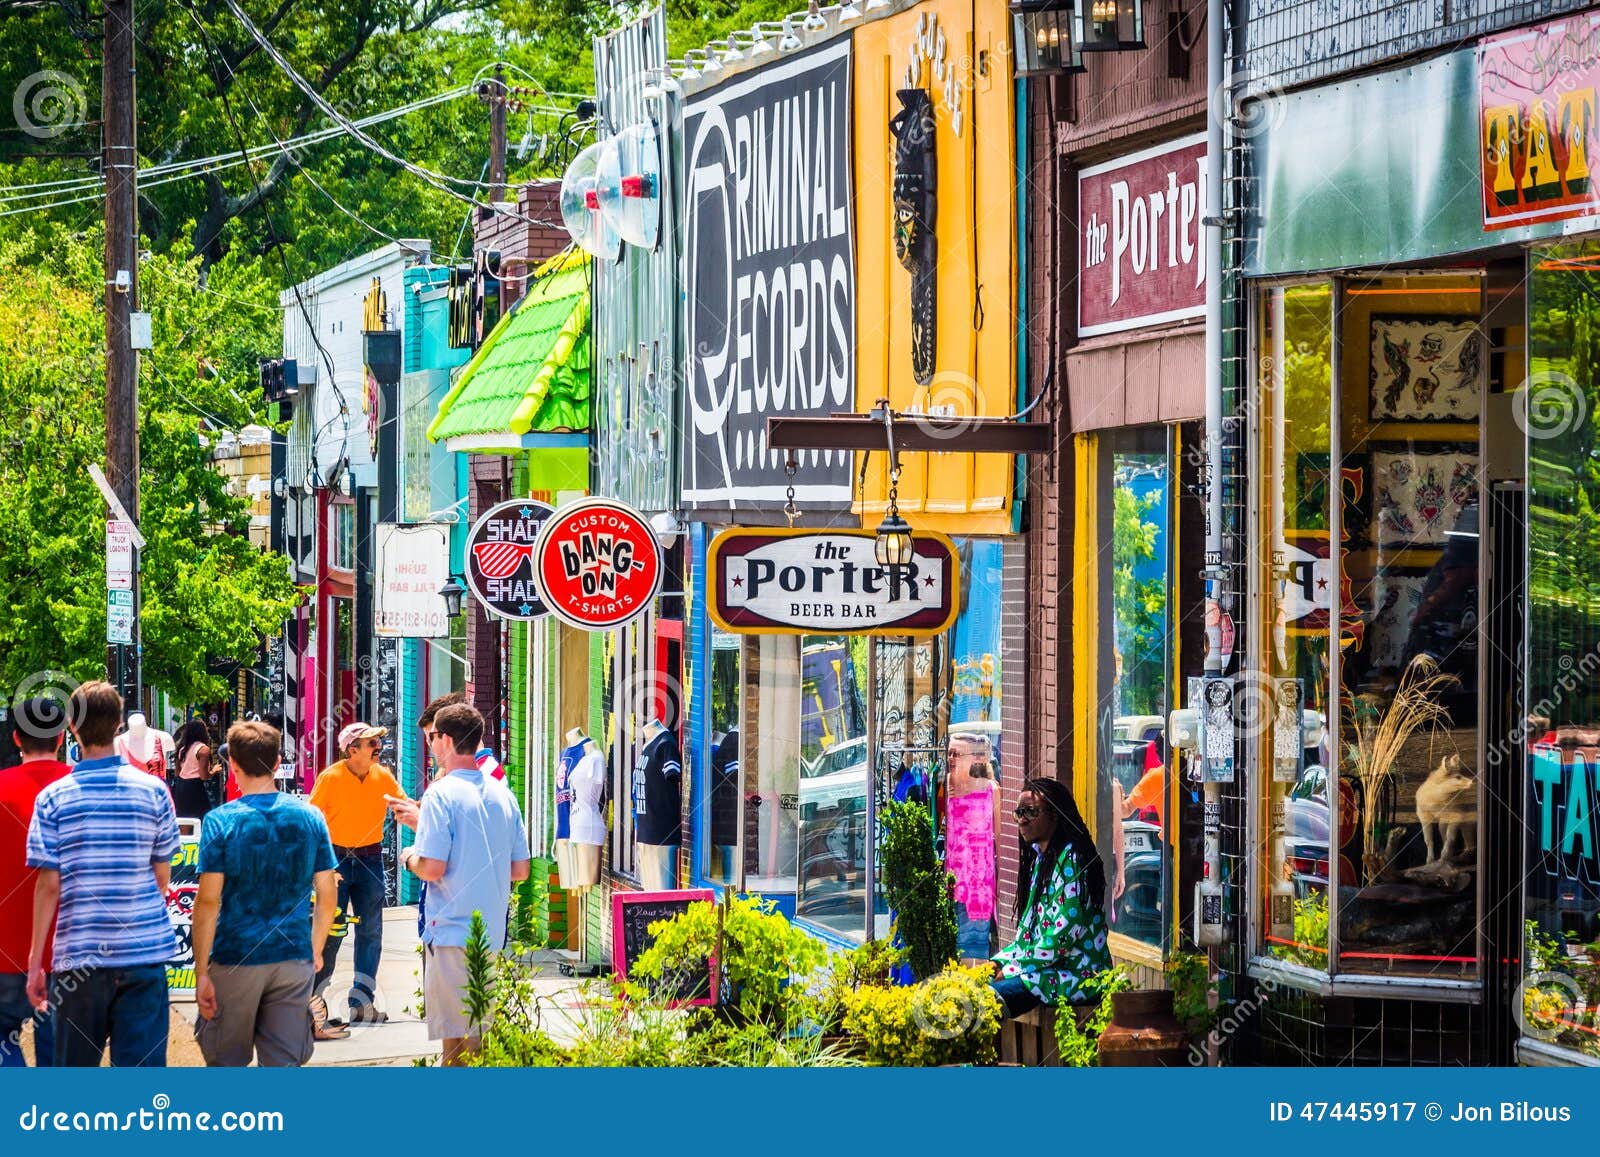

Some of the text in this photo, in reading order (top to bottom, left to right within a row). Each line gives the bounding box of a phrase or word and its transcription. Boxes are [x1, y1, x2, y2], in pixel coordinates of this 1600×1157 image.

[1086, 212, 1108, 269] the
[569, 514, 630, 534] CUSTOM
[814, 541, 851, 560] the
[583, 571, 615, 595] ON
[569, 594, 633, 615] T-SHIRTS
[790, 603, 877, 618] BEER BAR
